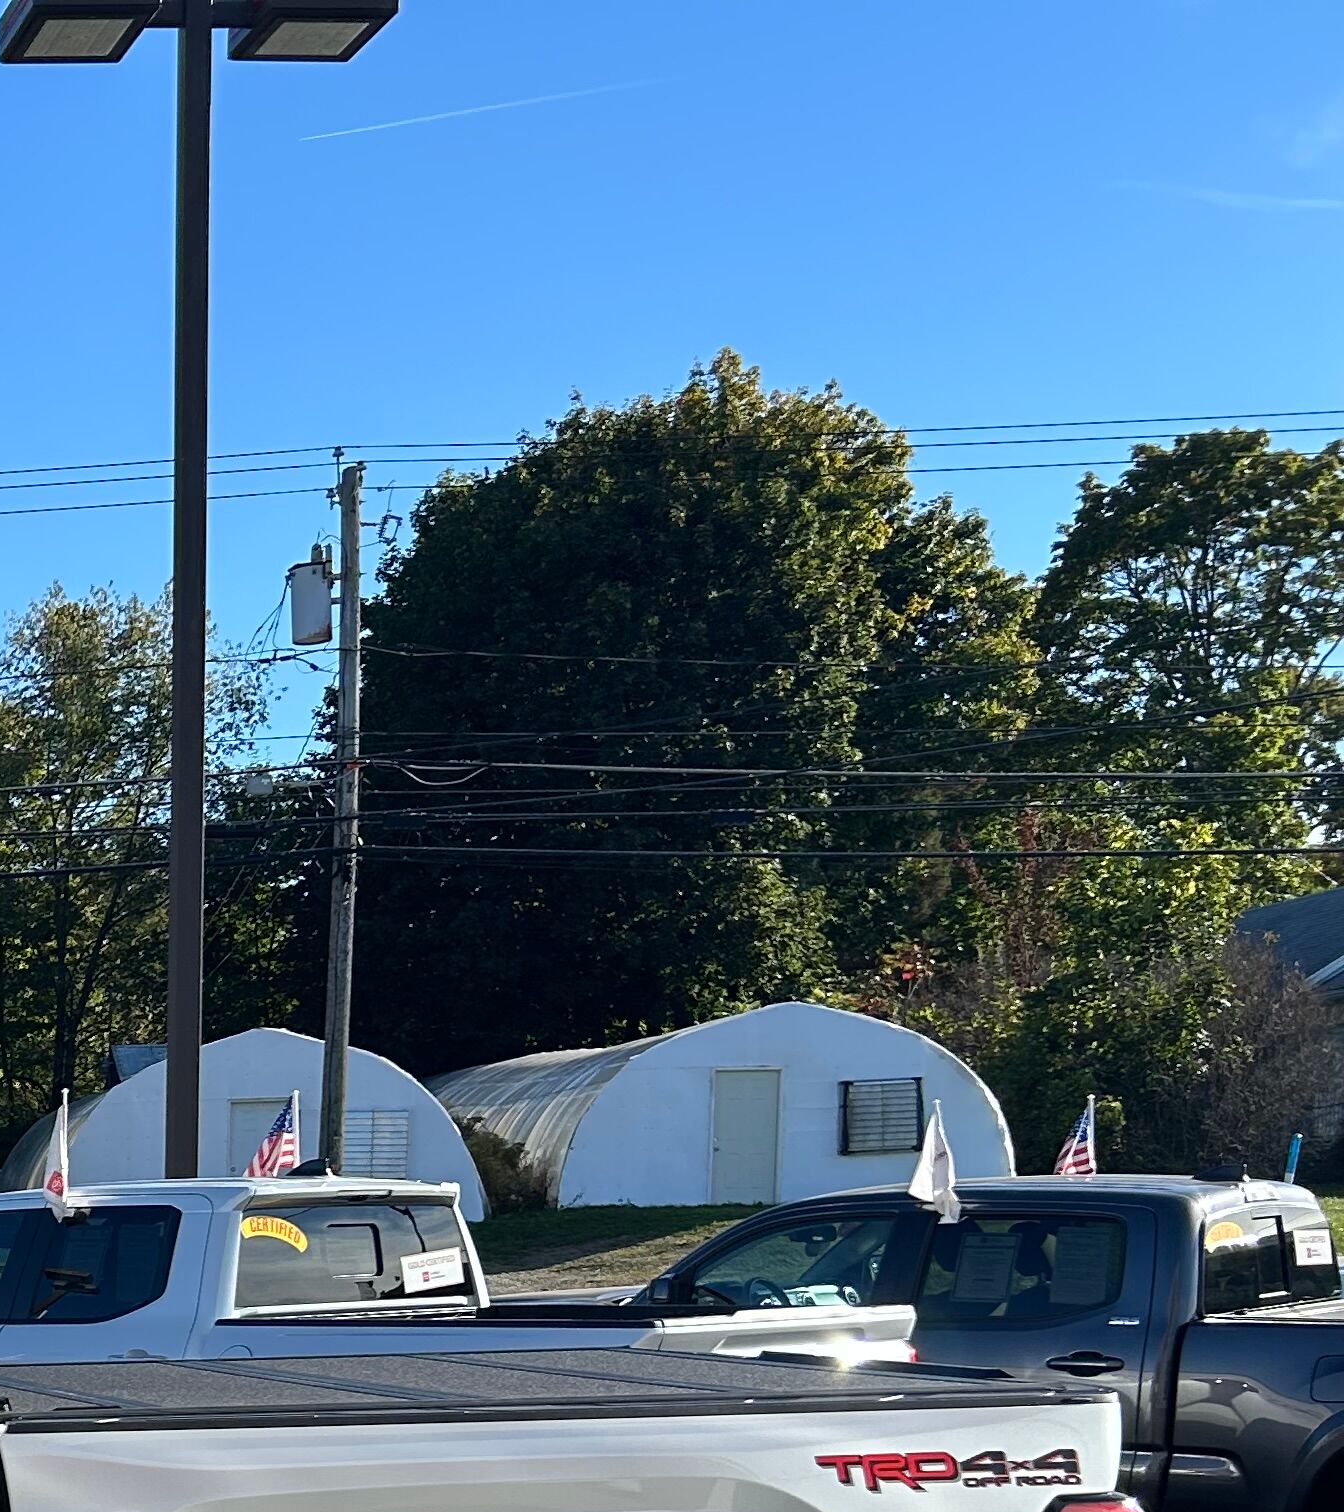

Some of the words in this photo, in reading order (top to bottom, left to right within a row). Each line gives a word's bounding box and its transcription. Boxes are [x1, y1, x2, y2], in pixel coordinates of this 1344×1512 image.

[249, 1216, 301, 1243] CERTIFIED
[814, 1451, 959, 1493] TRD
[962, 1476, 1012, 1489] OFF
[1015, 1475, 1083, 1488] ROAD
